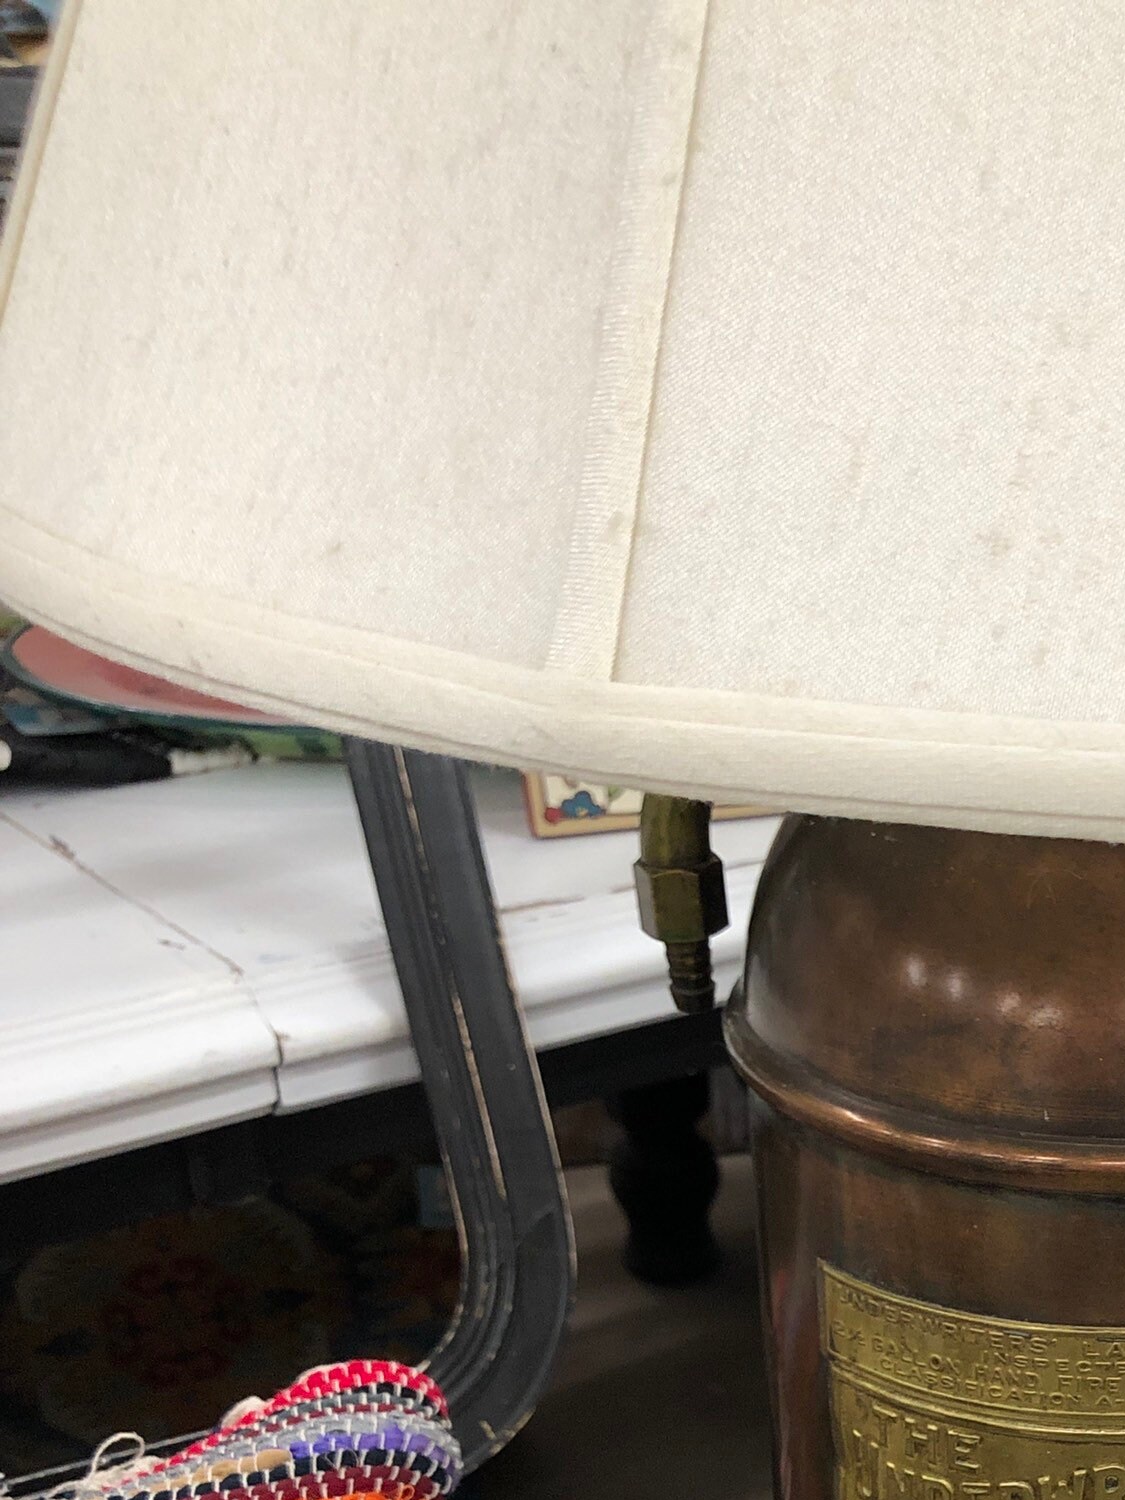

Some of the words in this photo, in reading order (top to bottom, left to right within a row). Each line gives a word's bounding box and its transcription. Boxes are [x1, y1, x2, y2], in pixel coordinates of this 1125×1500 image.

[880, 1355, 1082, 1406] CLASSIFICATION
[975, 1362, 1039, 1389] HAND
[1058, 1374, 1122, 1393] FIRE
[872, 1404, 982, 1474] THE
